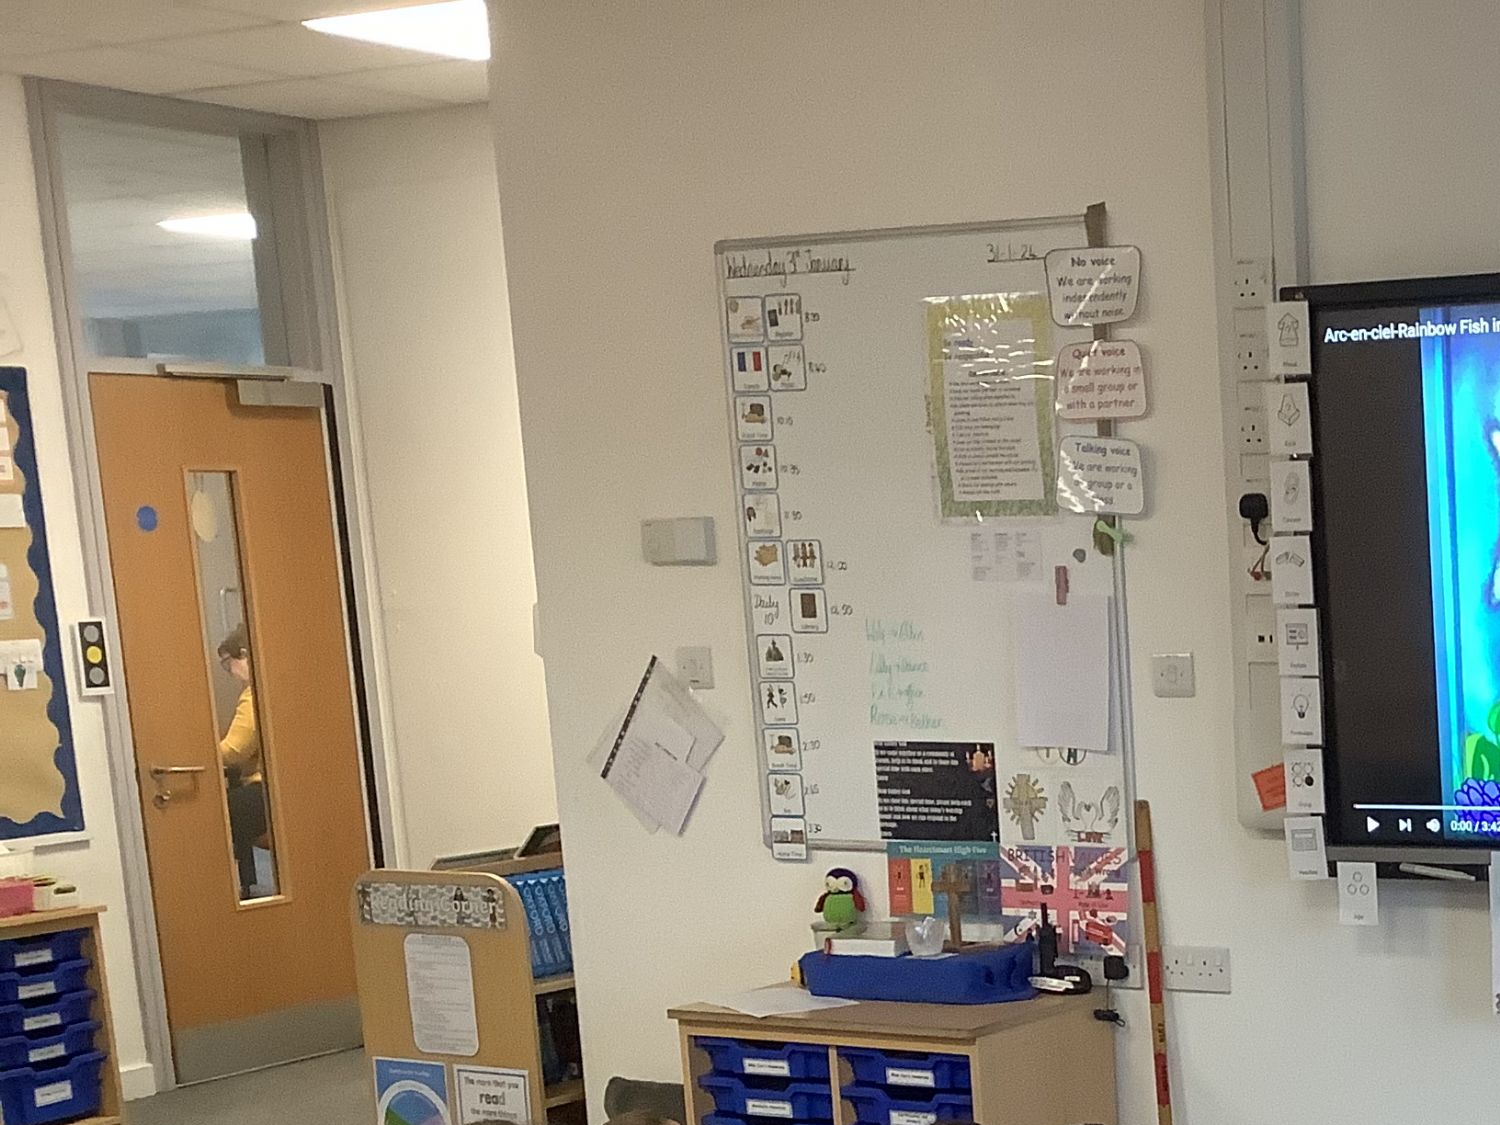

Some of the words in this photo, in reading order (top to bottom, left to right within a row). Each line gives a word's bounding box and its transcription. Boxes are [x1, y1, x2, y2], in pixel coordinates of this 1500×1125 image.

[1071, 257, 1086, 268] No
[1091, 257, 1115, 266] voice
[1056, 276, 1074, 287] We
[1076, 278, 1093, 286] are
[1460, 317, 1489, 334] Fish
[1101, 347, 1126, 357] voice
[1060, 368, 1074, 378] We
[1094, 365, 1131, 378] working
[1071, 382, 1094, 394] small
[1097, 382, 1125, 395] group
[1127, 383, 1139, 391] or
[1066, 399, 1087, 410] with
[1098, 399, 1135, 411] partner
[1075, 442, 1107, 457] Talking
[1110, 447, 1131, 457] voice
[1086, 463, 1102, 472] are
[1105, 464, 1138, 478] working
[1088, 480, 1113, 492] group
[1115, 482, 1125, 490] or
[1450, 820, 1473, 832] 0:00
[899, 846, 913, 854] The
[954, 846, 971, 855] High
[1007, 848, 1066, 864] BRITISH
[438, 897, 496, 915] Corner
[464, 1076, 475, 1085] The
[476, 1078, 492, 1086] more
[493, 1078, 506, 1088] that
[507, 1081, 519, 1090] you
[479, 1092, 506, 1105] read
